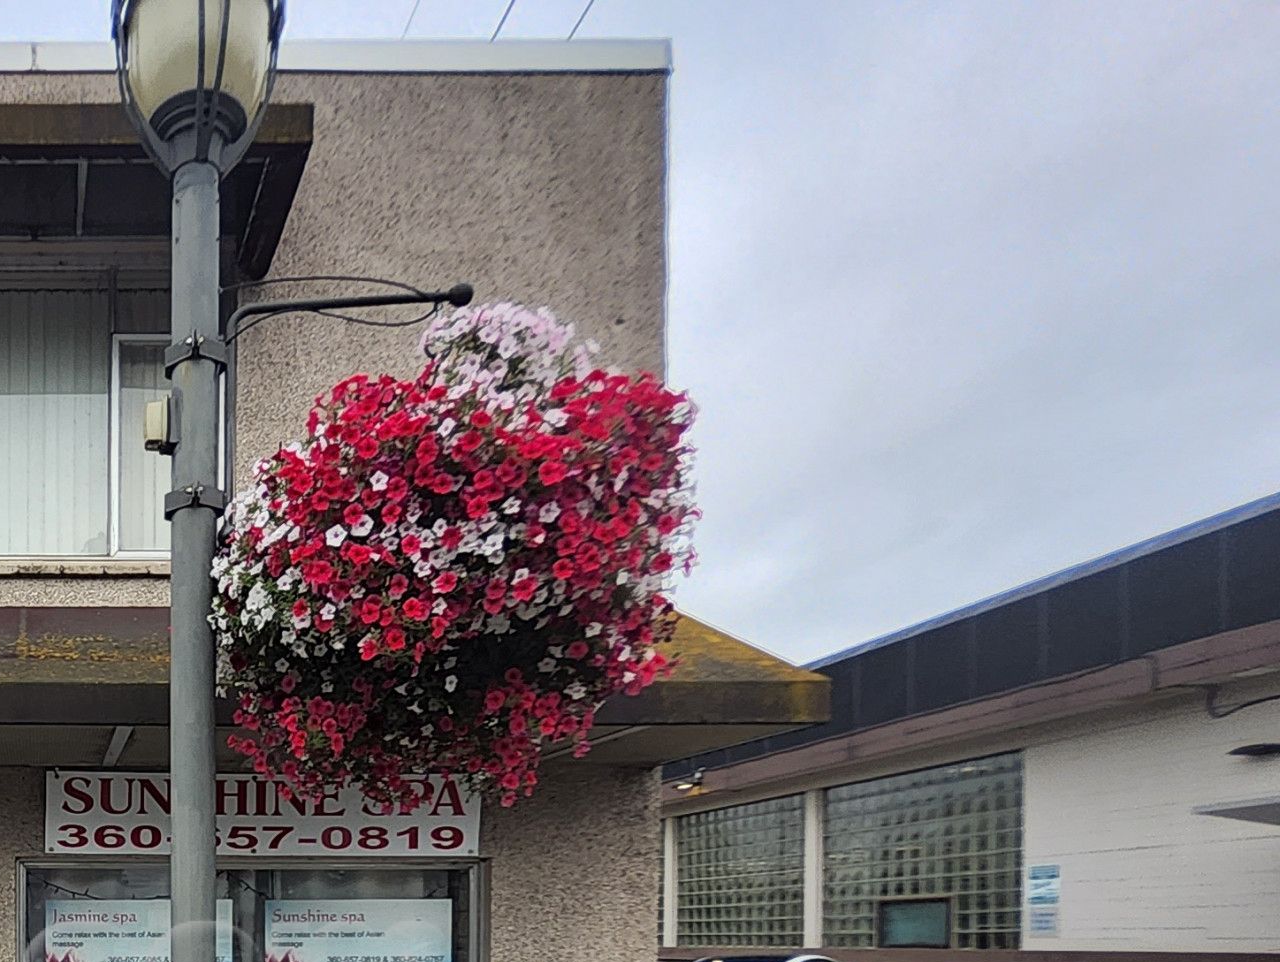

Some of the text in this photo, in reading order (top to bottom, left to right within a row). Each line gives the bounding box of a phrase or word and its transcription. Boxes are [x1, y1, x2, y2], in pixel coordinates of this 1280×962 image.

[61, 776, 345, 817] SUNHINE
[57, 824, 464, 850] 36057-0819
[52, 909, 137, 926] Jasmine spa
[272, 909, 365, 925] Sunshine spa
[138, 930, 146, 938] of
[328, 930, 339, 938] the
[357, 930, 365, 938] of
